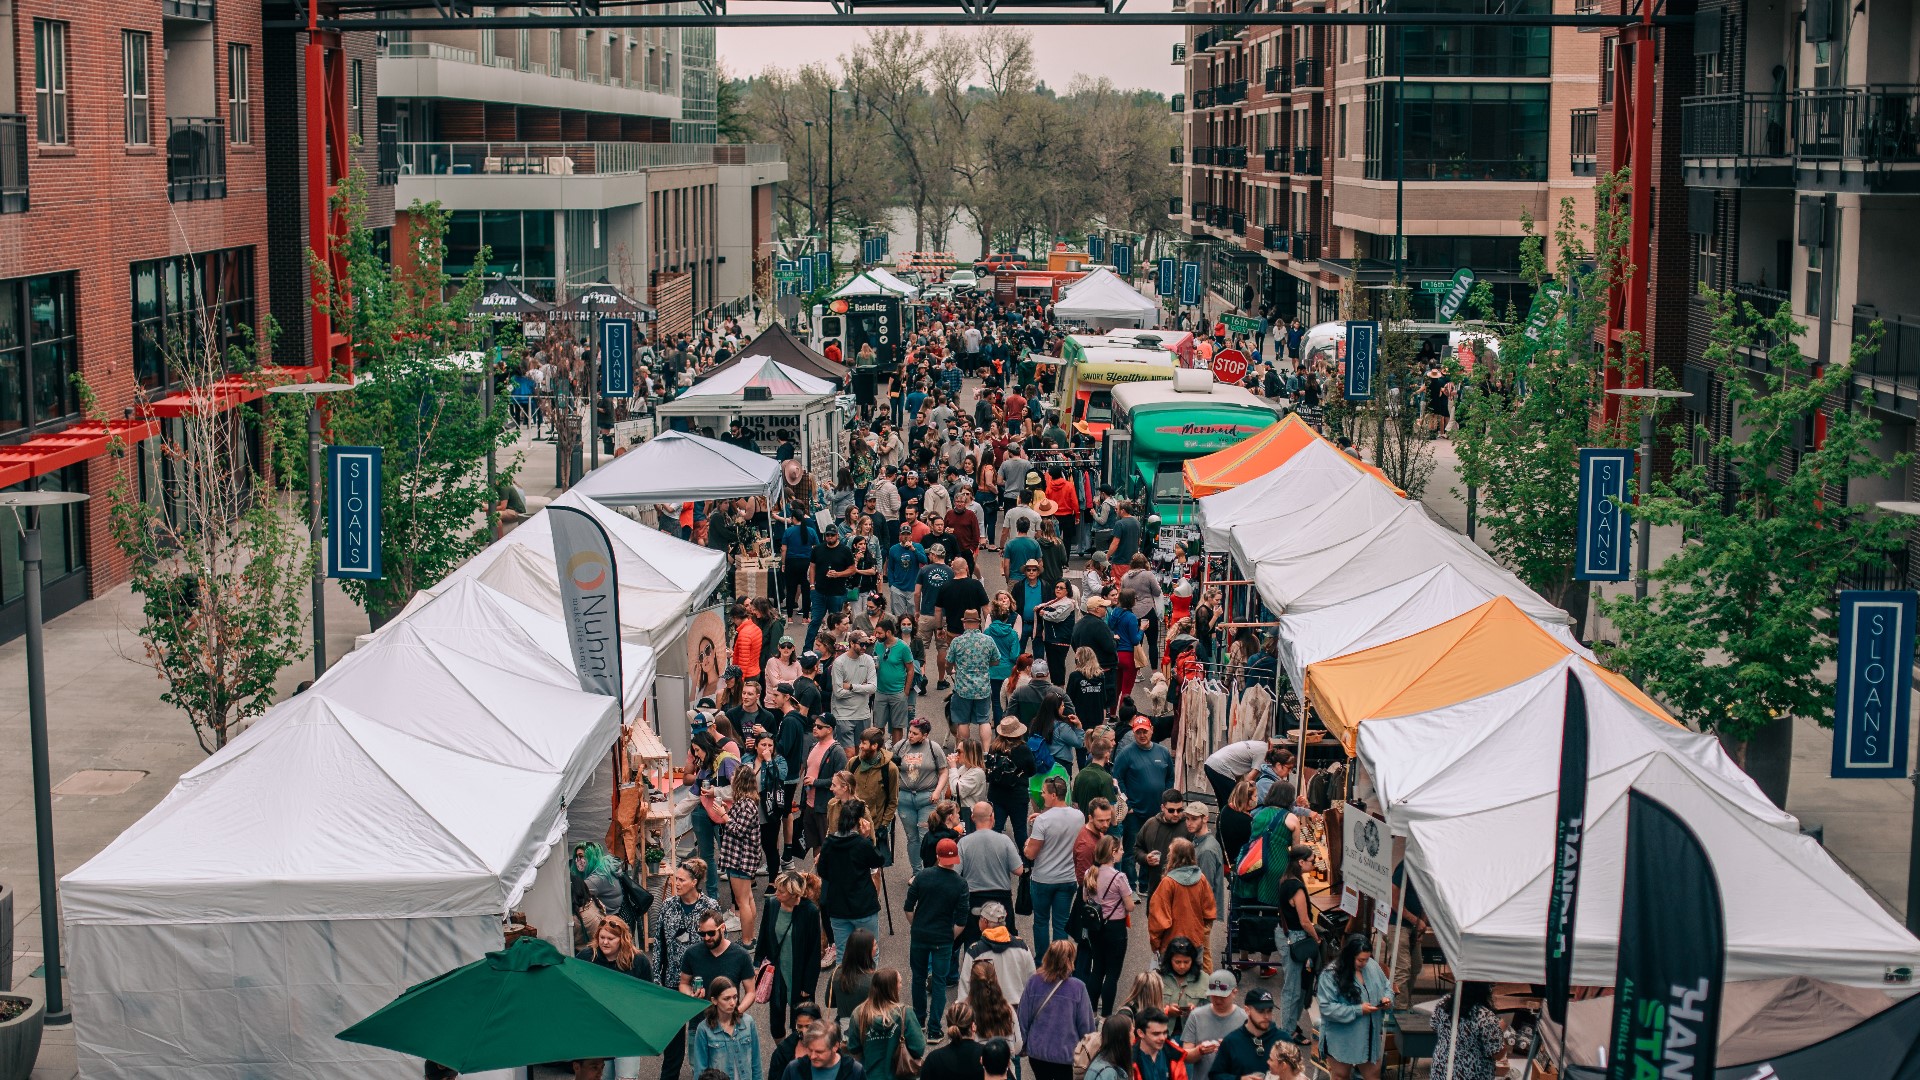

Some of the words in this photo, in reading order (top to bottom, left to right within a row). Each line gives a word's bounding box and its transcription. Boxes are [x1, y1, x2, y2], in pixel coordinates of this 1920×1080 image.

[482, 296, 518, 305] BAZAAR
[582, 295, 618, 304] BAAR
[855, 303, 875, 312] Basted
[875, 302, 887, 312] Egg
[1440, 275, 1473, 320] RUNA
[1231, 316, 1248, 327] 16th
[611, 328, 622, 389] SLOANS
[1082, 373, 1104, 381] SAVORY
[1215, 357, 1246, 375] STOP
[1356, 330, 1366, 391] SLOANS
[1181, 423, 1237, 437] Mermaid
[346, 462, 363, 565] SLOANS
[1597, 465, 1613, 567] SLOANS
[573, 598, 581, 623] make
[581, 594, 613, 679] Nuhni
[1863, 614, 1885, 756] SLOANS
[1622, 977, 1634, 1002] ALL
[1616, 1008, 1632, 1062] THRILLS
[1633, 998, 1666, 1080] STA
[1662, 976, 1710, 1080] HAN
